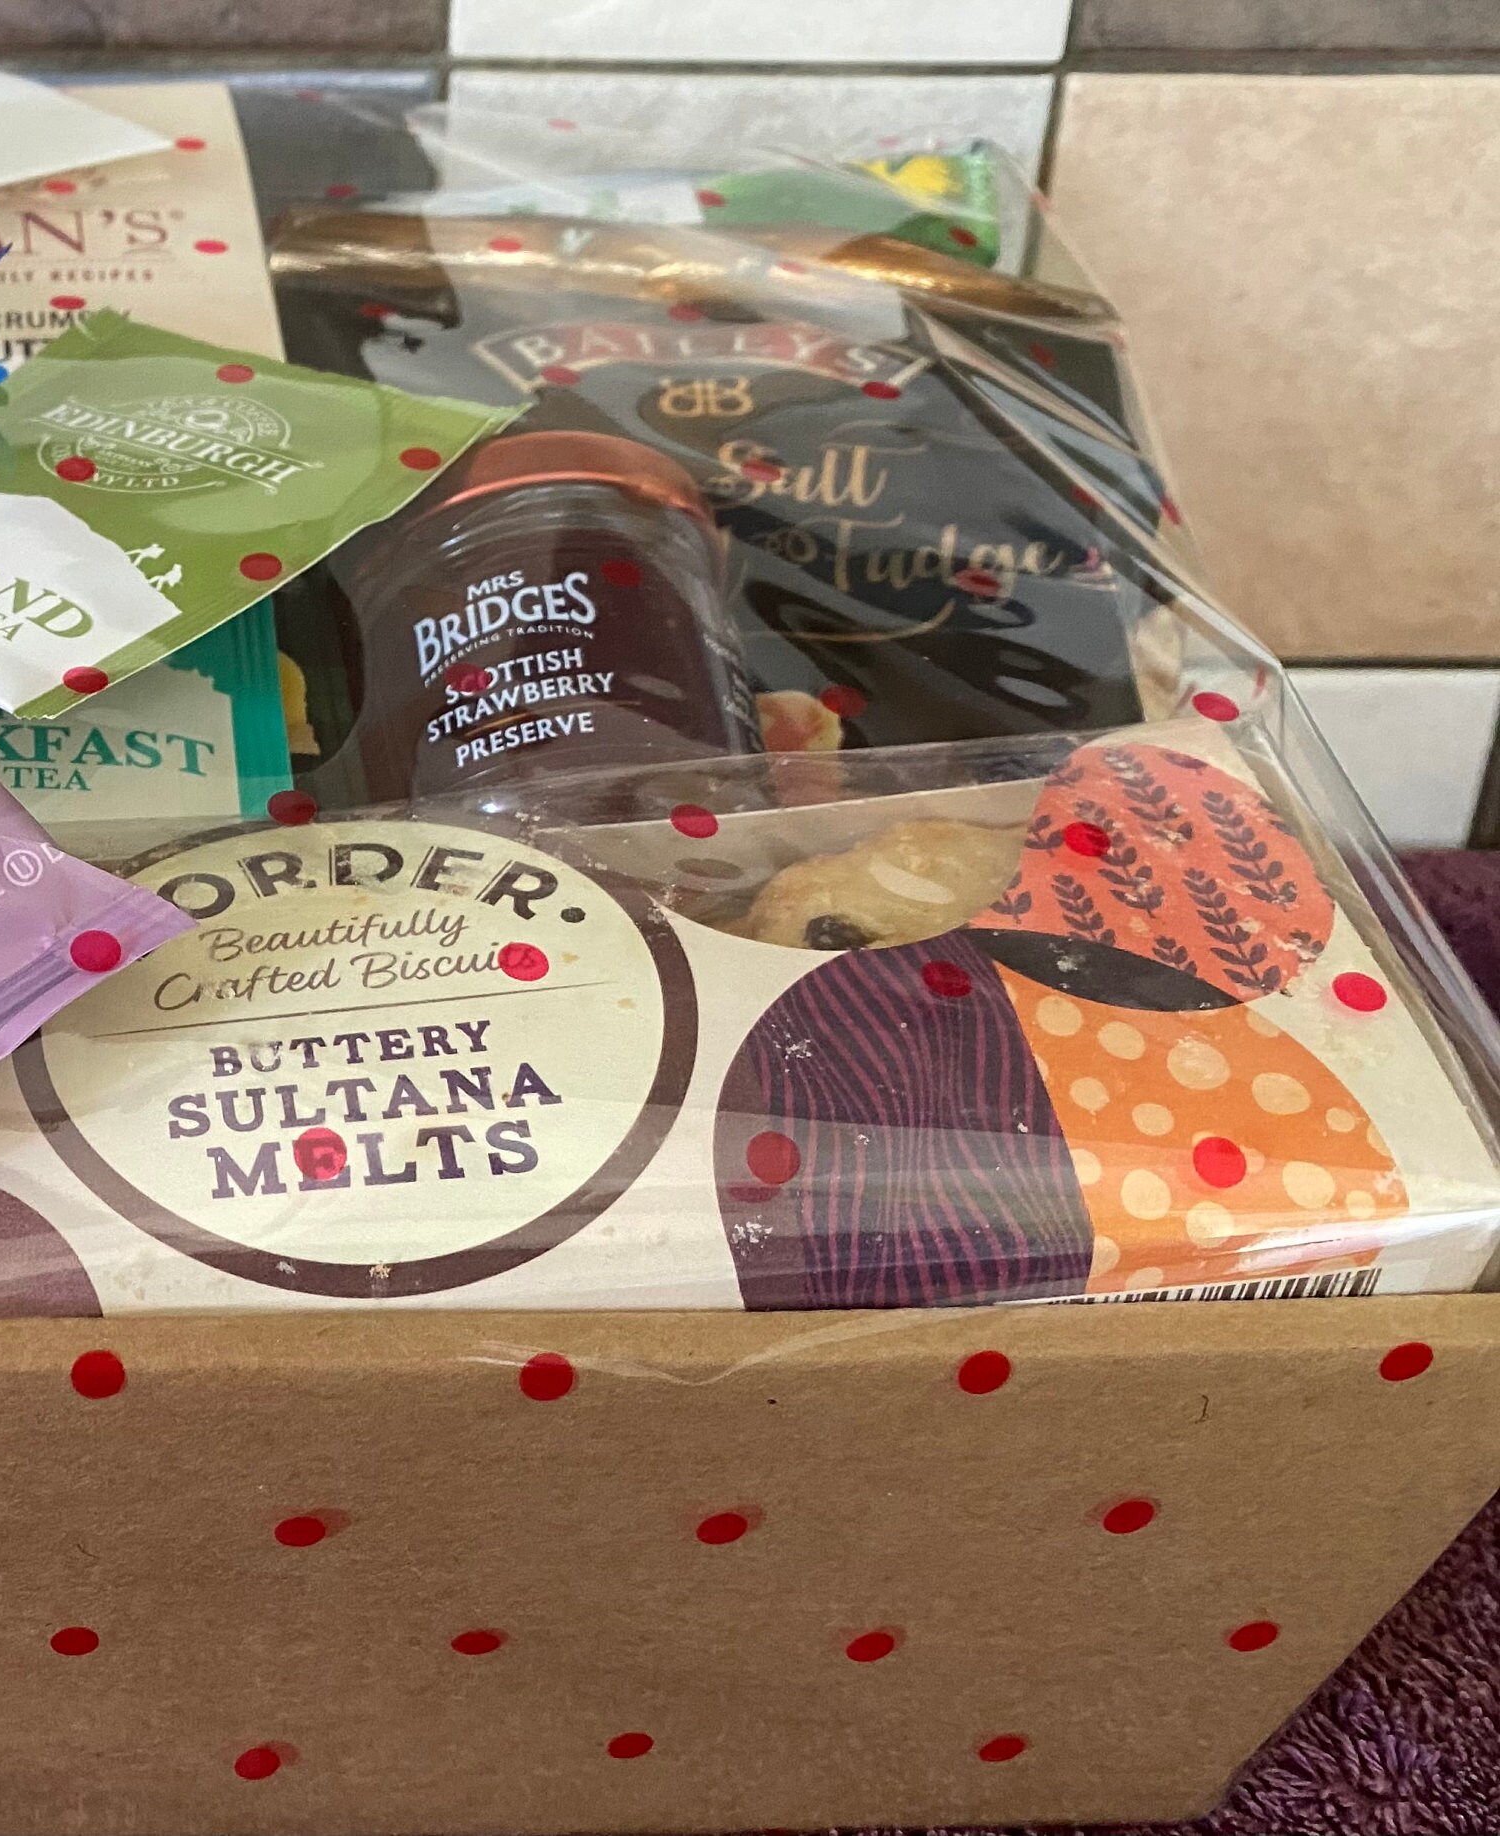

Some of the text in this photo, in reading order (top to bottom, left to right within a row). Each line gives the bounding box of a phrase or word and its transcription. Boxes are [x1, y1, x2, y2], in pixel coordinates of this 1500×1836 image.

[42, 403, 306, 485] EDINBURGH
[466, 569, 525, 602] MRS
[413, 571, 597, 677] BRIDGES
[506, 624, 595, 641] TRADITION
[444, 647, 584, 705] SOTTISH
[426, 671, 616, 743] STRAWBERRY
[455, 711, 596, 769] PRESERVE
[3, 765, 92, 792] TEA
[156, 842, 587, 924] ORDER.
[199, 907, 470, 963] Beautifully
[152, 961, 342, 1013] Crafted
[209, 1019, 492, 1079] BUTTERY
[167, 1061, 563, 1140] SULTANA
[206, 1118, 540, 1200] MELTS
